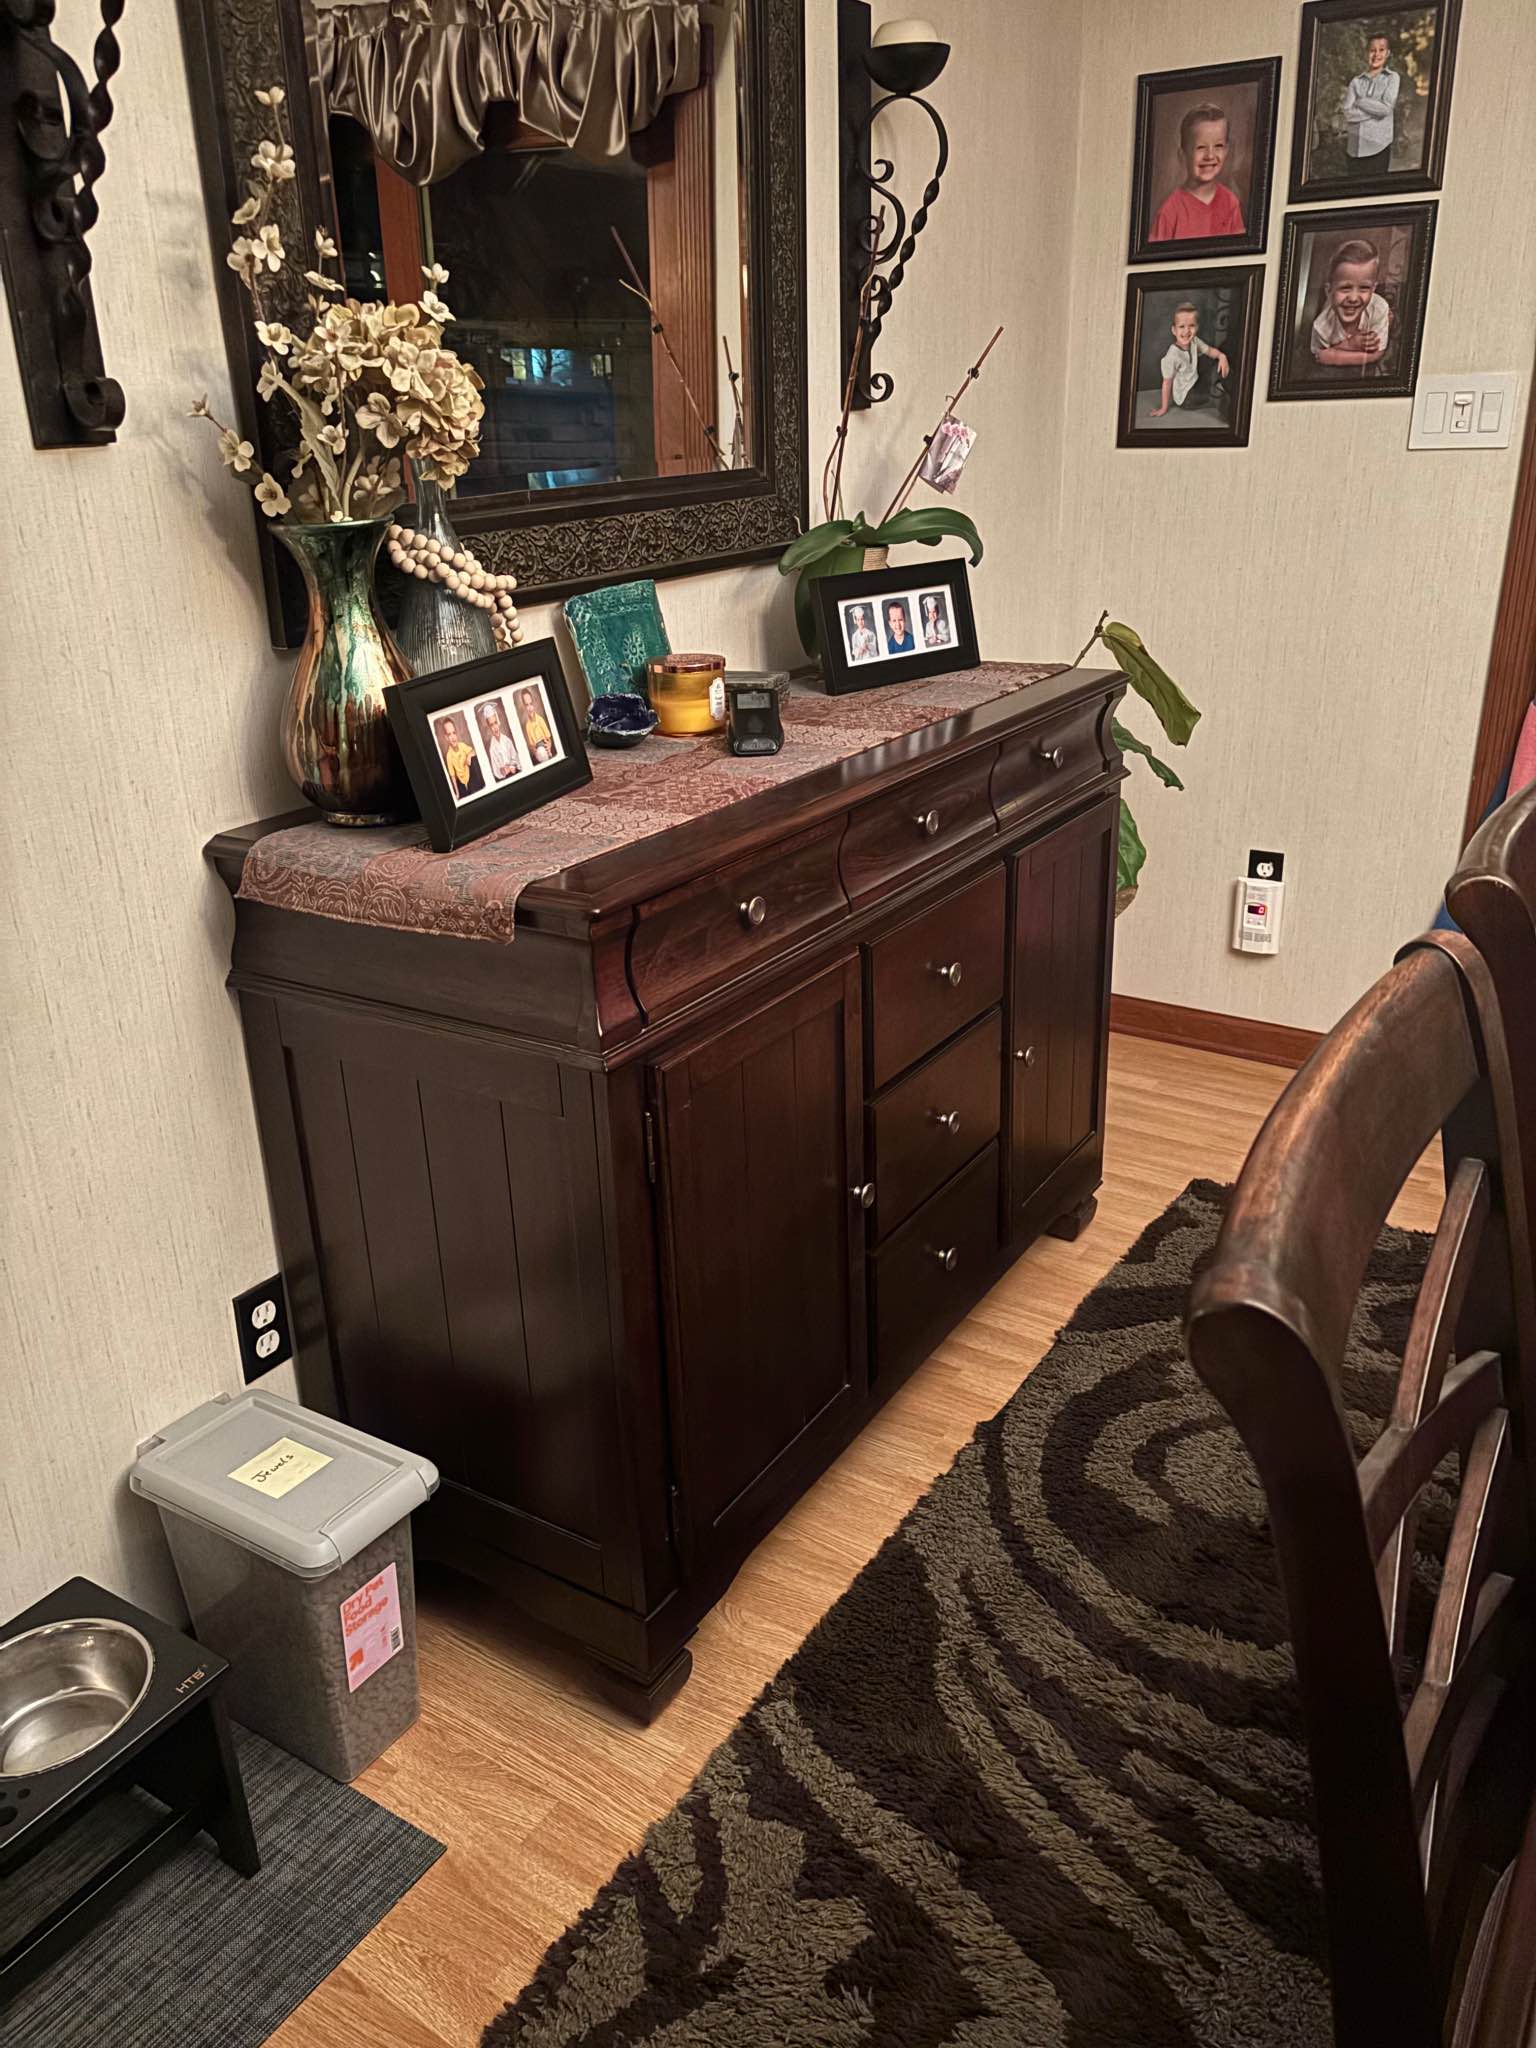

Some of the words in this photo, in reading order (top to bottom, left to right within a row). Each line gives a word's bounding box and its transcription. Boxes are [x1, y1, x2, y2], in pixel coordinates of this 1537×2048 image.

[250, 1454, 295, 1483] Jewels
[343, 1593, 363, 1615] Dry
[344, 1595, 373, 1627] Food
[345, 1597, 388, 1637] Storage
